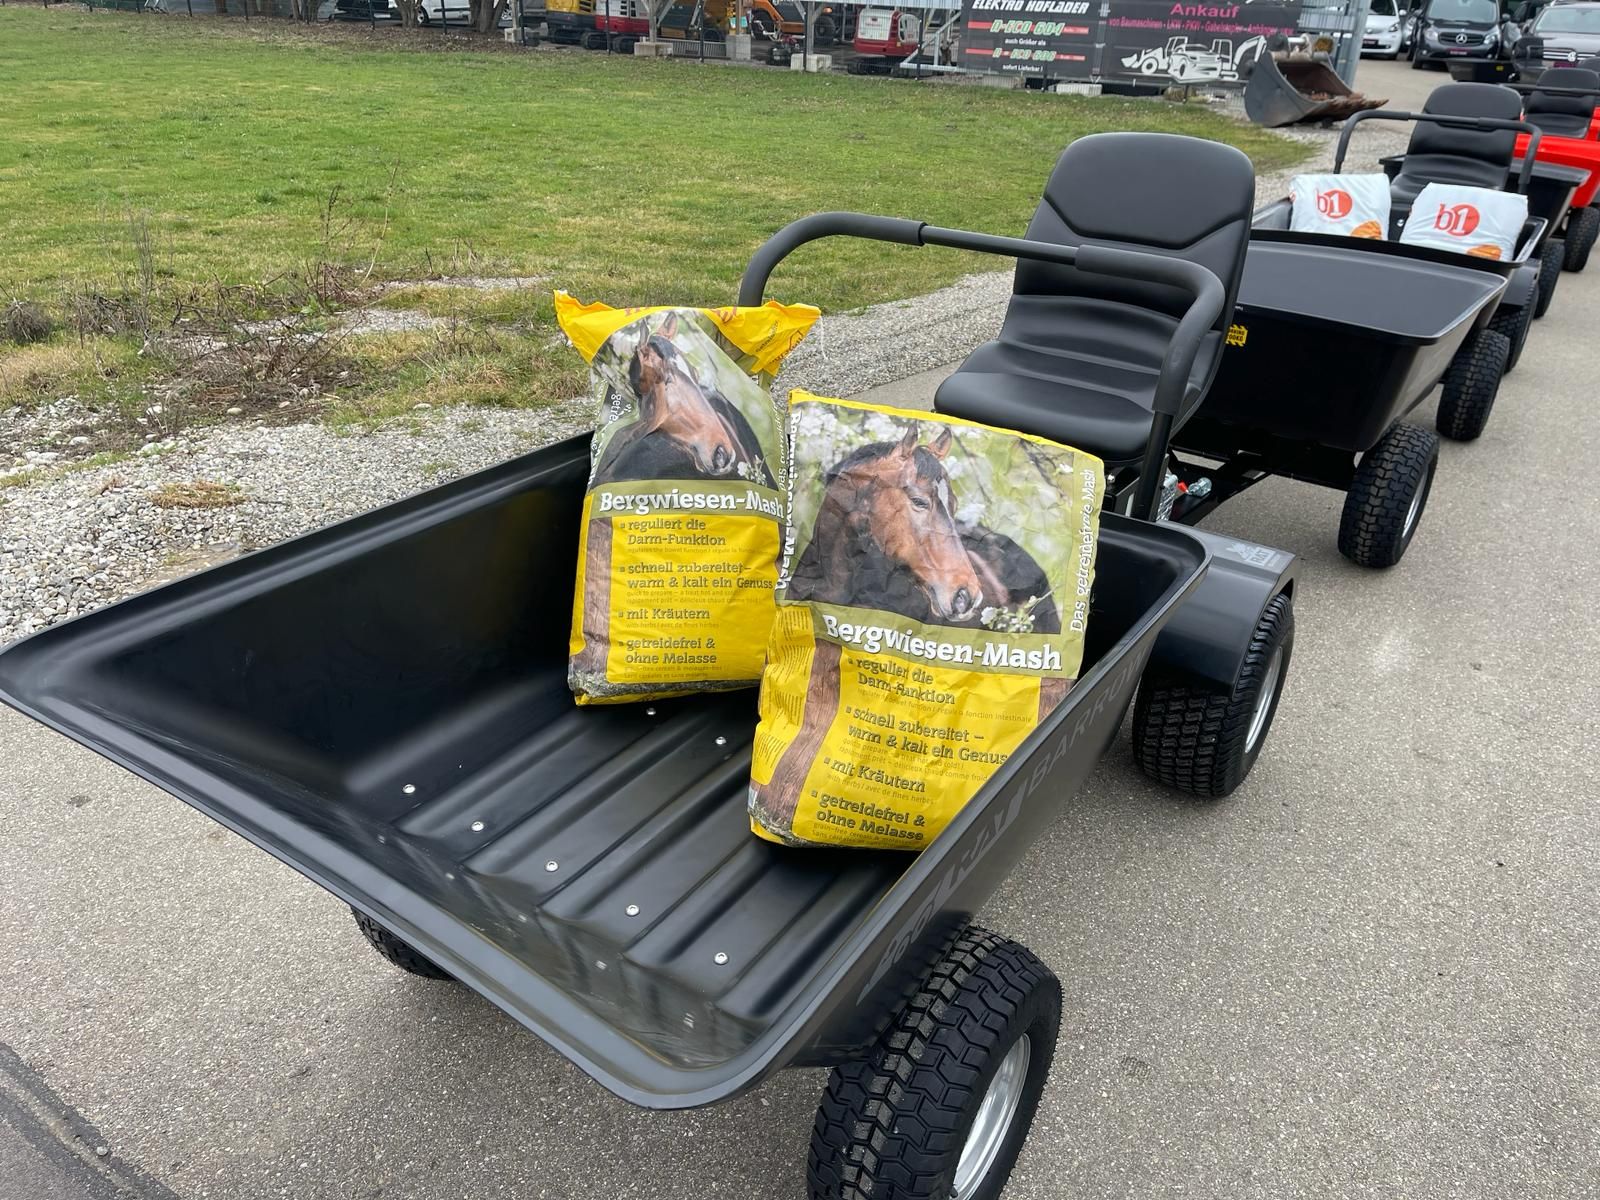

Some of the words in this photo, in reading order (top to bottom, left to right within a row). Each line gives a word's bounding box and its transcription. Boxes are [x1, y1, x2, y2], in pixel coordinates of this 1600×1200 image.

[1170, 3, 1240, 18] Ankauf
[1316, 187, 1347, 218] b1
[1434, 203, 1476, 236] b1
[600, 489, 784, 518] Bergwiesen-Mash
[628, 518, 682, 532] reguliert
[686, 519, 706, 530] die
[628, 534, 726, 546] Darm-Funktion
[1071, 600, 1086, 631] Das
[1080, 469, 1096, 502] Mash
[628, 562, 673, 574] schnell
[628, 578, 664, 588] warm
[668, 578, 678, 588] &
[683, 576, 708, 588] kalt
[712, 577, 732, 588] ein
[737, 577, 773, 589] Genuss
[627, 609, 648, 619] mit
[652, 608, 710, 619] Kräutern
[627, 637, 702, 650] getreidefrei
[706, 638, 715, 648] &
[822, 613, 1063, 670] Bergwiesen-Mash
[625, 652, 659, 663] ohne
[662, 653, 717, 664] Melasse
[912, 668, 934, 685] die
[899, 719, 969, 742] zubereitet
[886, 735, 897, 748] &
[902, 736, 928, 755] kalt
[932, 744, 953, 759] ein
[958, 748, 1008, 765] Genus
[831, 758, 856, 777] mit
[858, 764, 925, 792] Kräutern
[819, 793, 909, 824] getreidefrei
[913, 815, 925, 827] &
[816, 809, 856, 828] ohne
[859, 819, 924, 840] Melasse
